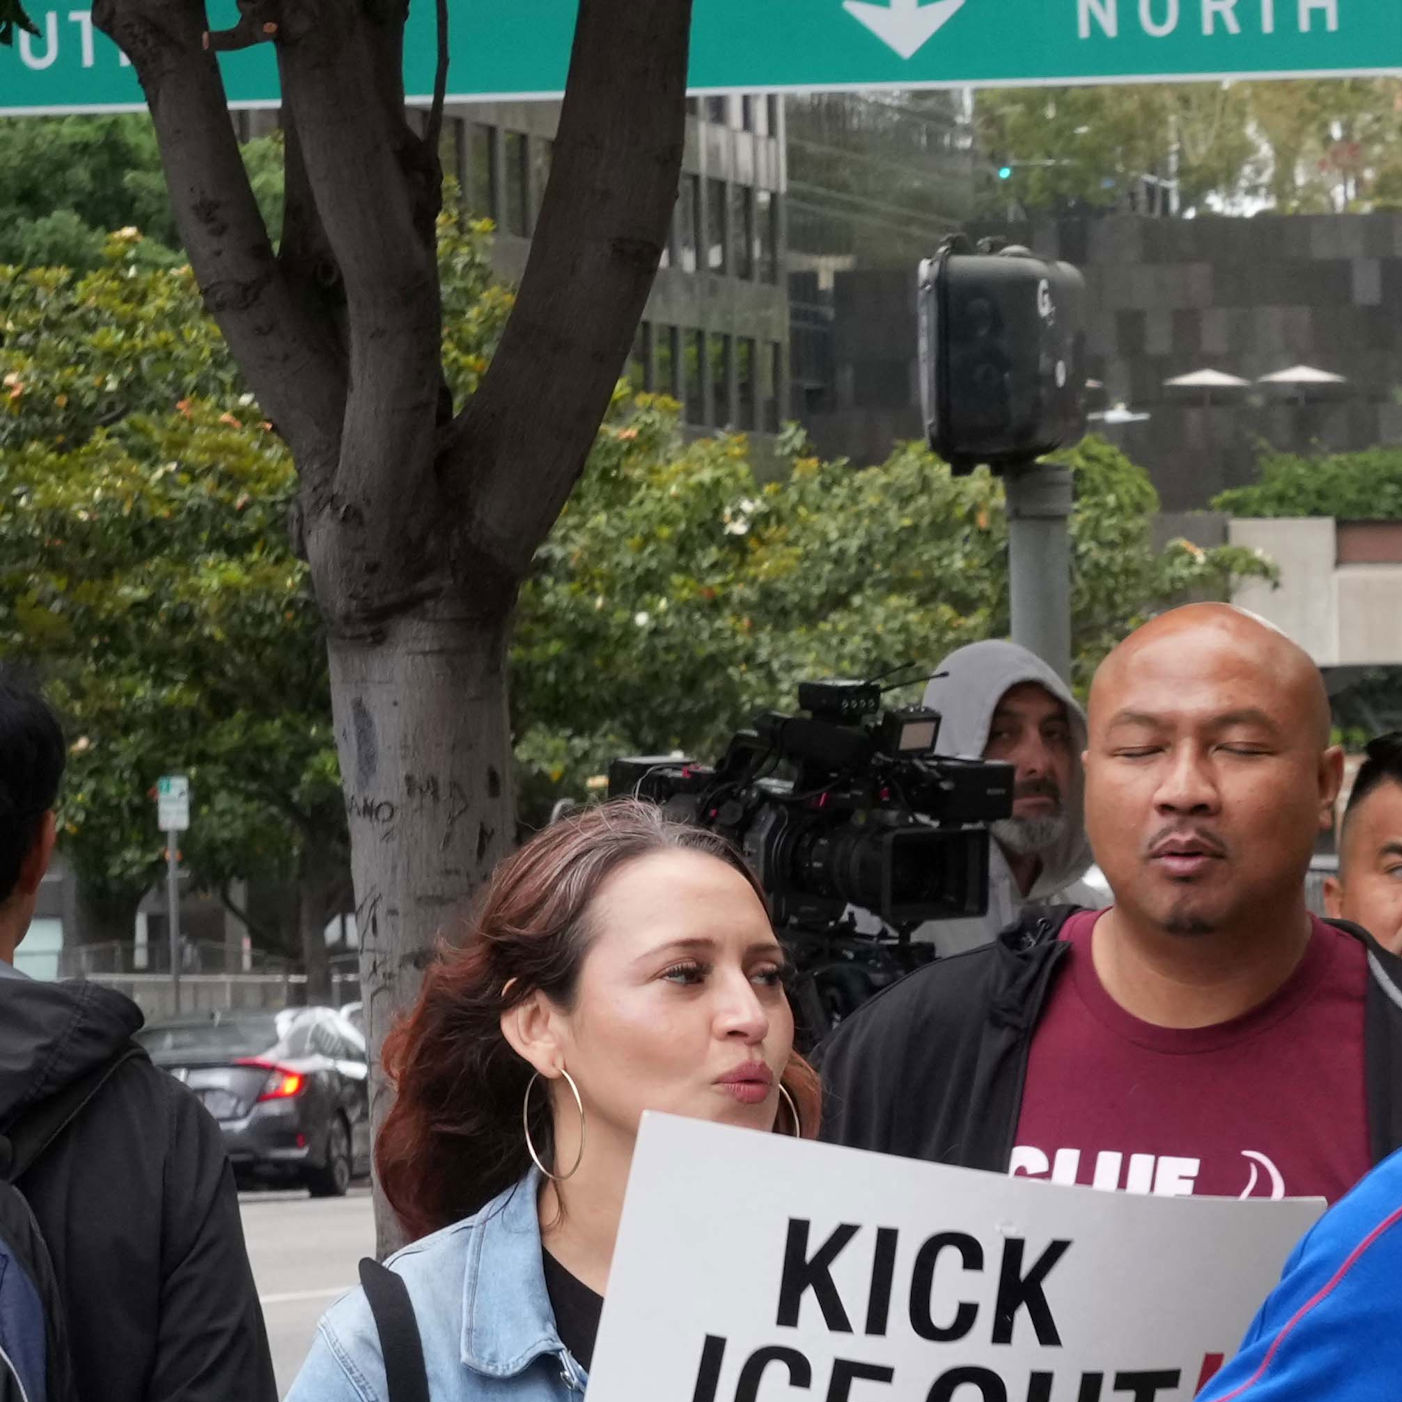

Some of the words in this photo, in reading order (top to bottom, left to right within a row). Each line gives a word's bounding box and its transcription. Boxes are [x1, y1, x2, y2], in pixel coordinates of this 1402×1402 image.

[19, 11, 131, 70] UT
[1077, 0, 1340, 39] NORTH
[775, 1217, 1074, 1348] KICK
